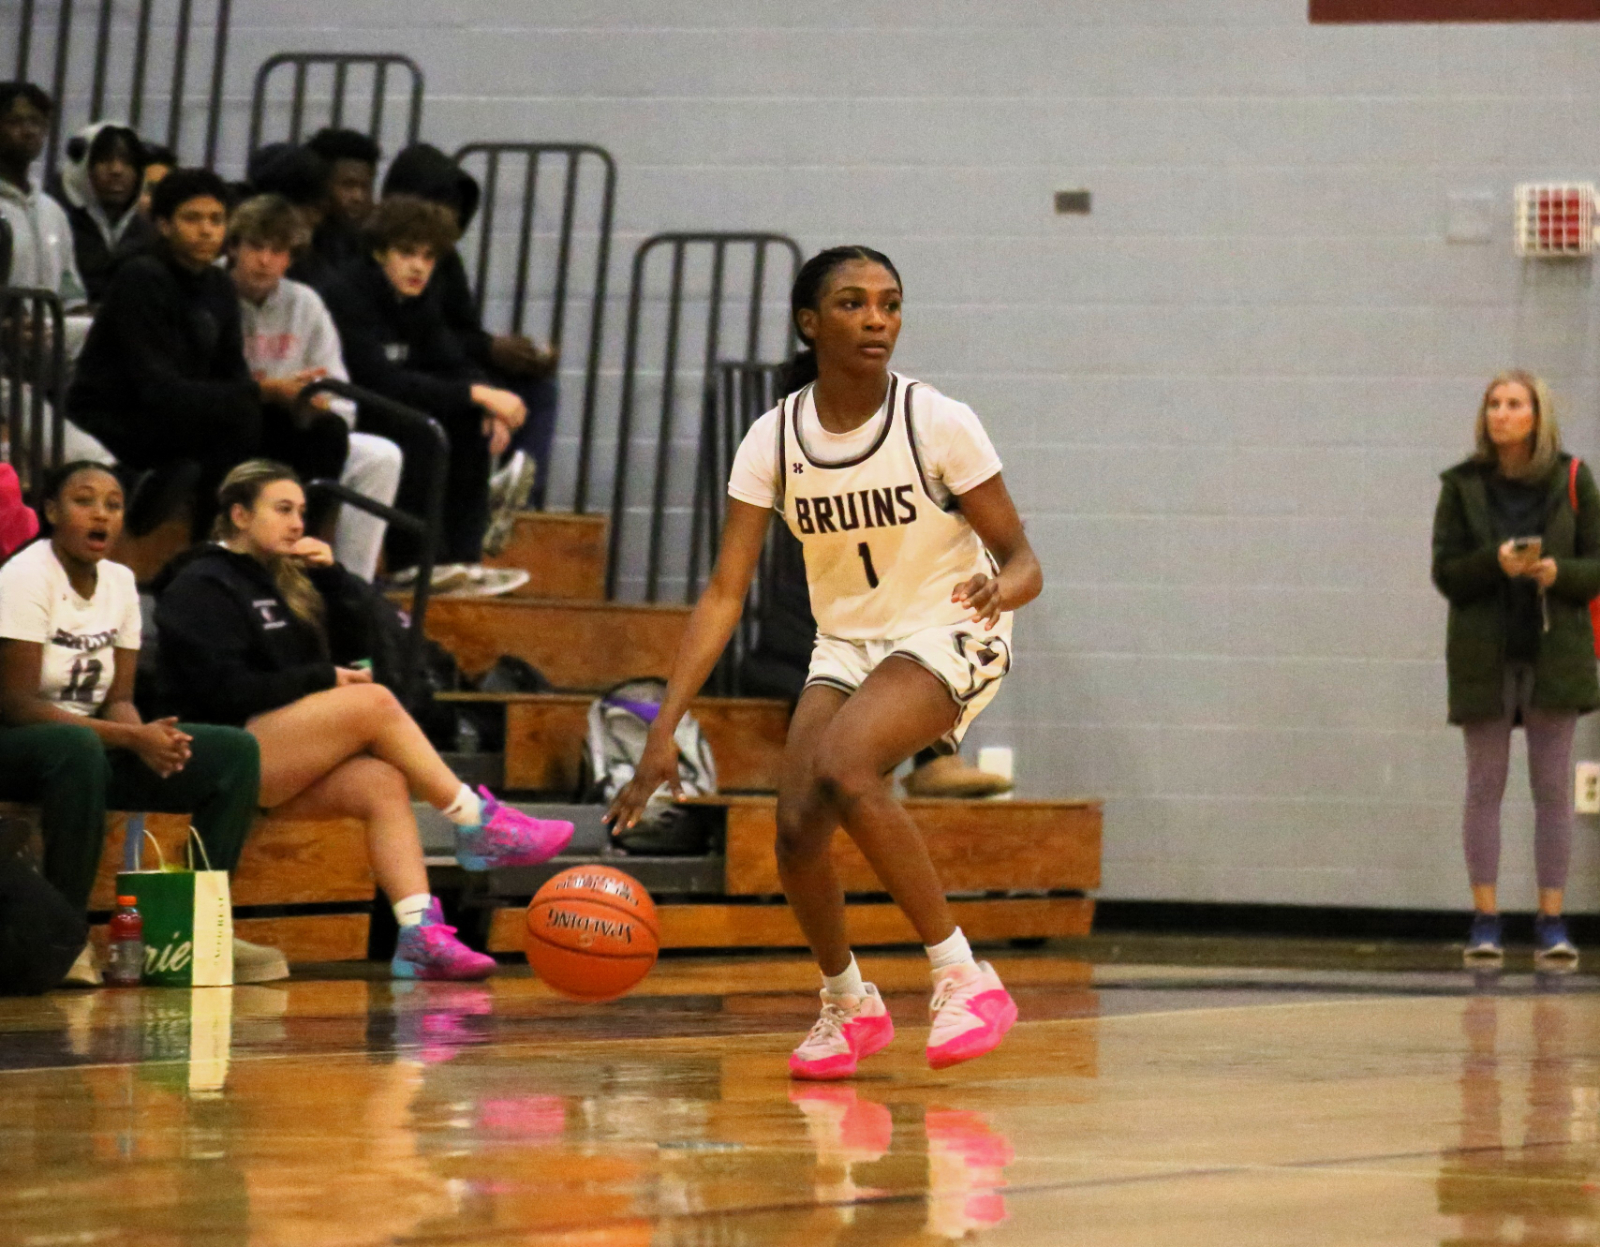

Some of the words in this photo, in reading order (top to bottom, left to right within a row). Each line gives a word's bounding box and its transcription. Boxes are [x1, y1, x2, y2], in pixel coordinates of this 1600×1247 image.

[795, 484, 917, 534] BRUINS
[858, 541, 879, 589] 1
[60, 658, 103, 702] 12
[546, 908, 635, 944] SPALDING
